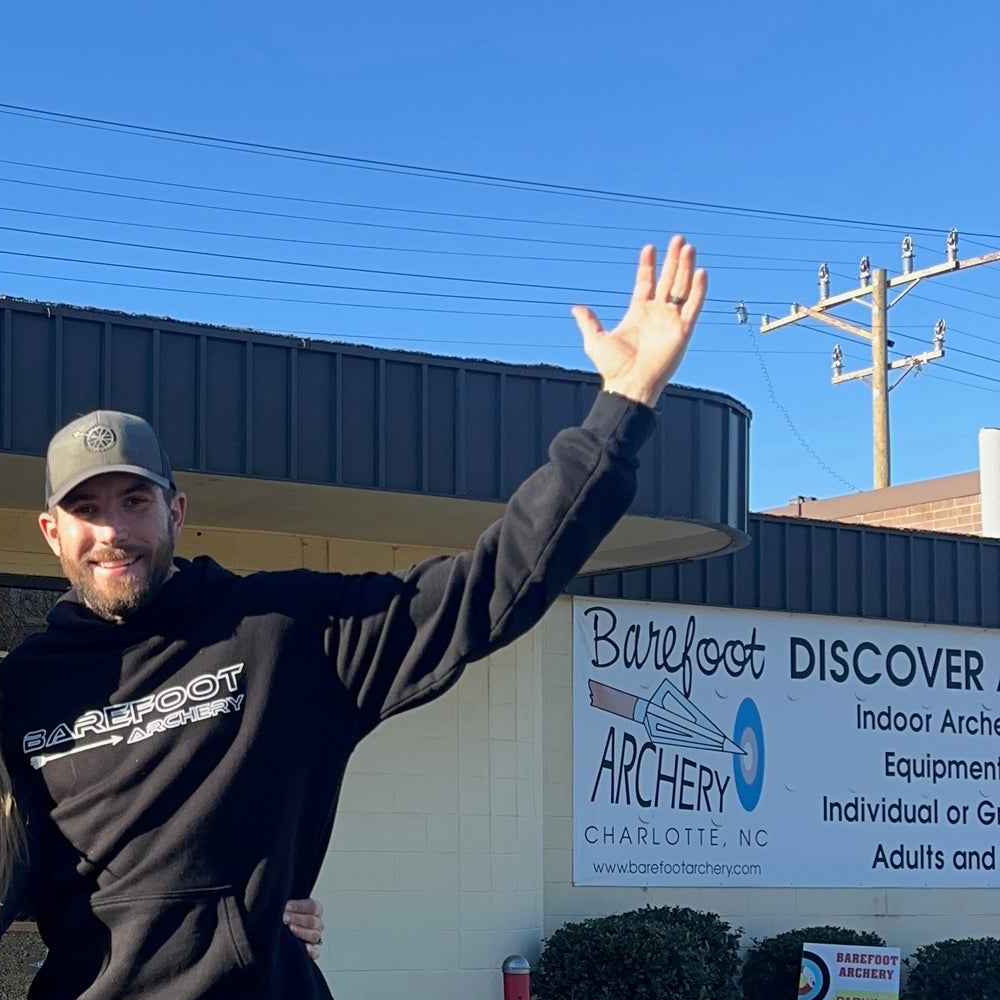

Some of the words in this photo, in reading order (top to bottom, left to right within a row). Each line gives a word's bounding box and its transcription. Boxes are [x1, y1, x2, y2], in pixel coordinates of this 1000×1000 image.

[584, 606, 766, 699] Barefoot
[790, 637, 984, 691] DISCOVER
[22, 662, 244, 753] BAREFOOT
[127, 694, 245, 744] ARCHERY
[856, 704, 932, 732] Indoor
[590, 726, 730, 813] ARCHERY
[823, 795, 939, 824] Individual
[946, 805, 969, 825] or
[584, 825, 727, 848] CHARLOTTE,
[739, 829, 769, 847] NC
[593, 860, 762, 878] www.barefootarchery.com
[872, 843, 945, 870] Adults
[953, 845, 996, 870] and
[836, 952, 899, 966] BAREFOOT
[838, 967, 895, 980] ARCHERY
